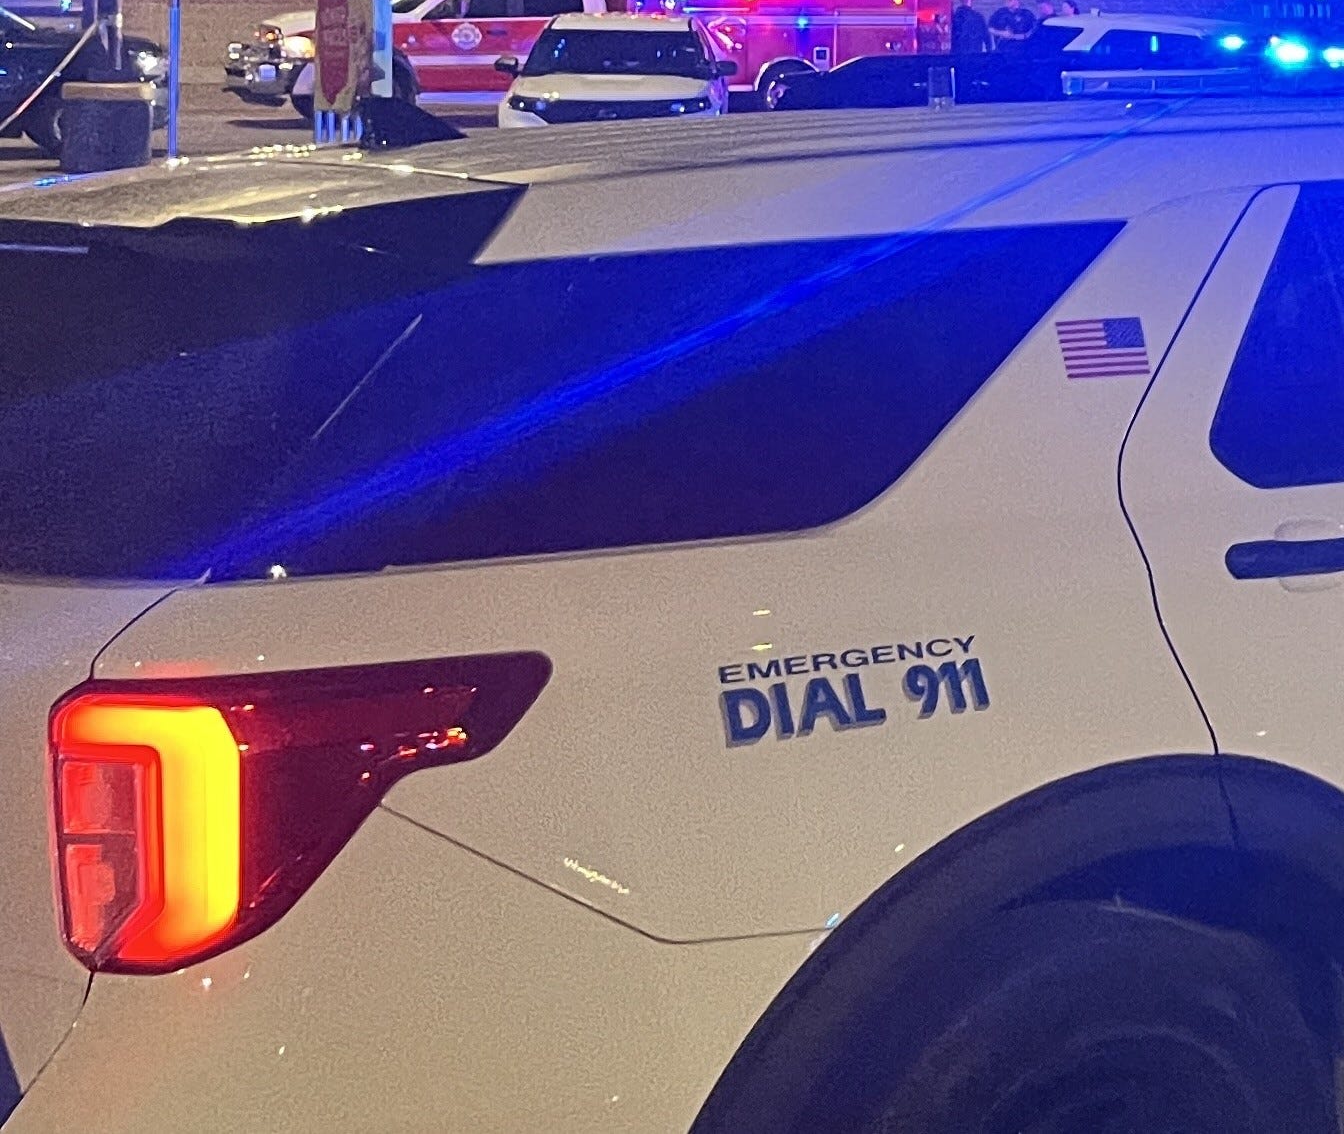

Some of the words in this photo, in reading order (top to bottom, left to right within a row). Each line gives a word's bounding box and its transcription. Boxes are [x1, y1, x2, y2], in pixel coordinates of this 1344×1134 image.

[718, 634, 976, 685] EMERGENCY
[719, 672, 887, 749] DIAL
[902, 657, 991, 720] 911
